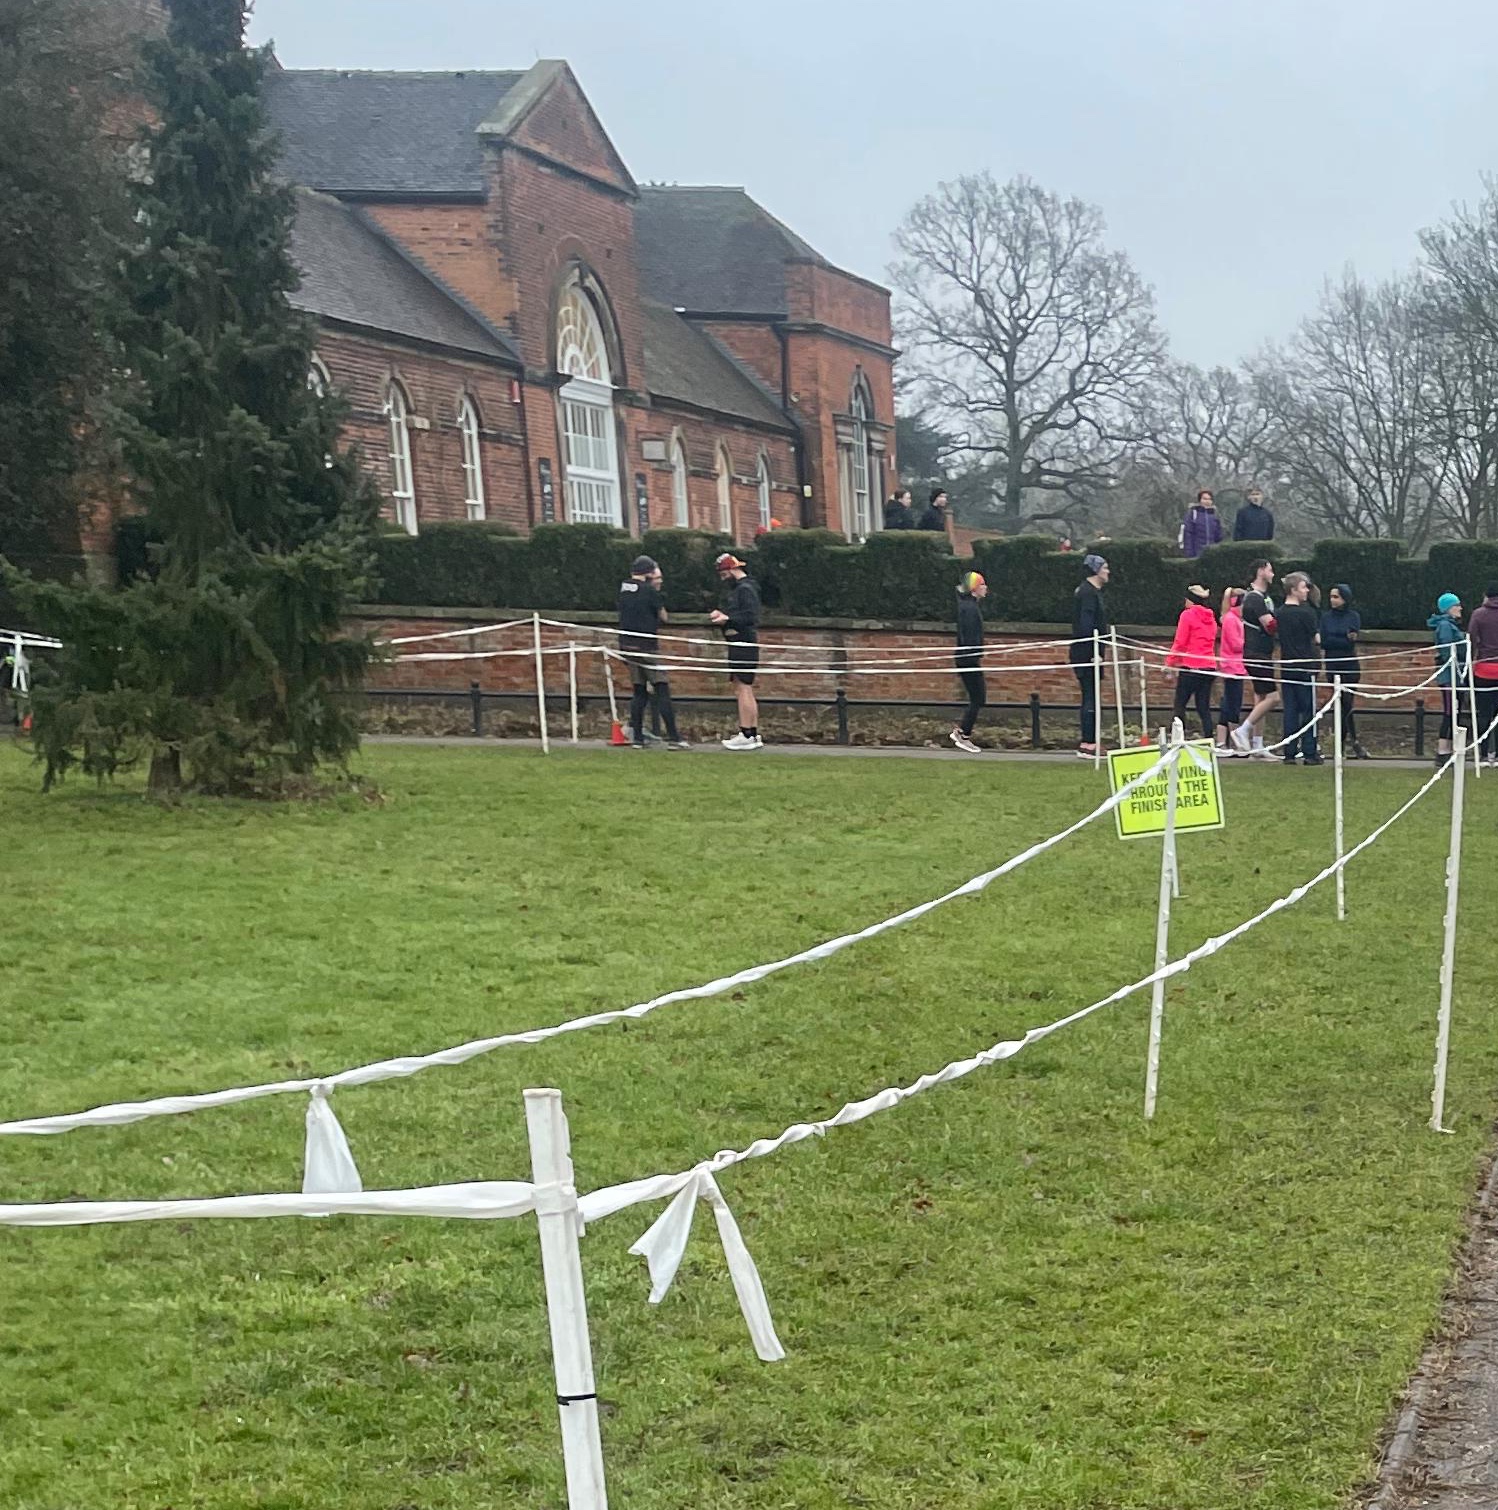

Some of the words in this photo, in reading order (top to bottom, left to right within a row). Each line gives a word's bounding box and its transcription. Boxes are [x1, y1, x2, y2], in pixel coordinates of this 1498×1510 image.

[1122, 772, 1149, 786] KEE
[1157, 766, 1207, 782] MVING
[1130, 782, 1181, 799] HROU
[1184, 779, 1209, 793] THE
[1176, 793, 1209, 809] AREA
